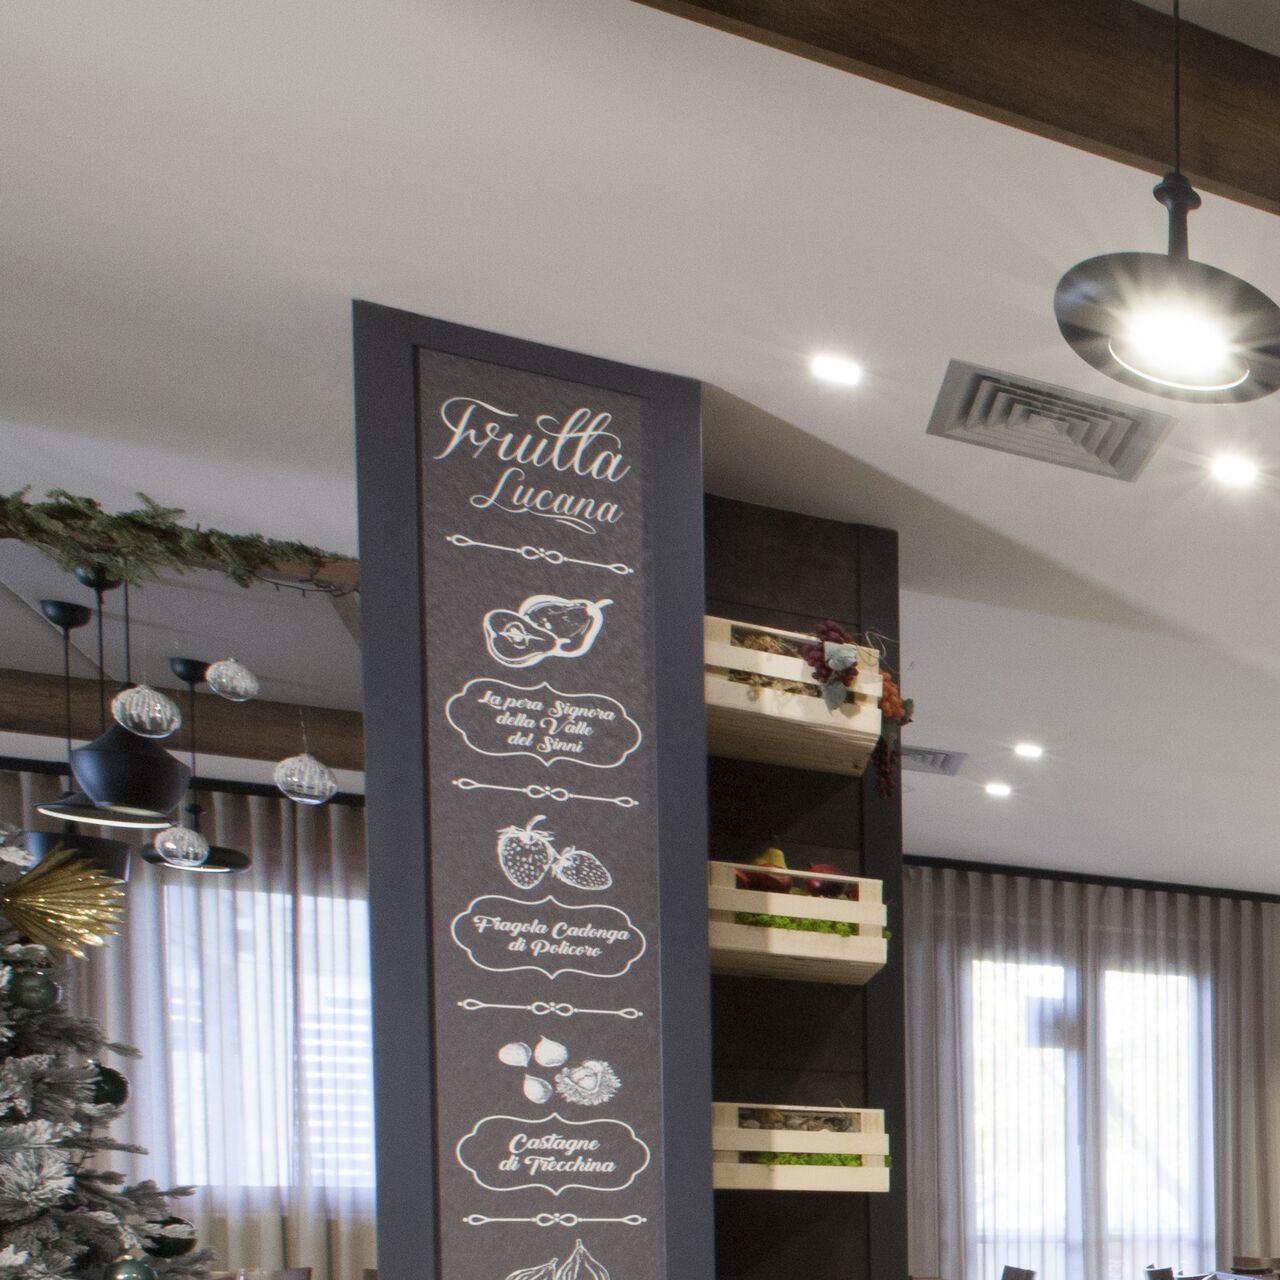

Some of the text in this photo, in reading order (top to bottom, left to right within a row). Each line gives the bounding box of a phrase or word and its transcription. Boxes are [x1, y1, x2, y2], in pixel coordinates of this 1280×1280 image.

[433, 397, 631, 482] Frutta
[470, 467, 624, 534] Lucana
[477, 690, 616, 722] La pera Signora
[496, 711, 594, 736] della Valle
[508, 731, 584, 754] del Sinni
[473, 915, 630, 943] Fragola Cadonga
[508, 937, 603, 958] di Policoro
[509, 1133, 600, 1155] Castagne
[499, 1155, 616, 1177] di Trecchina
